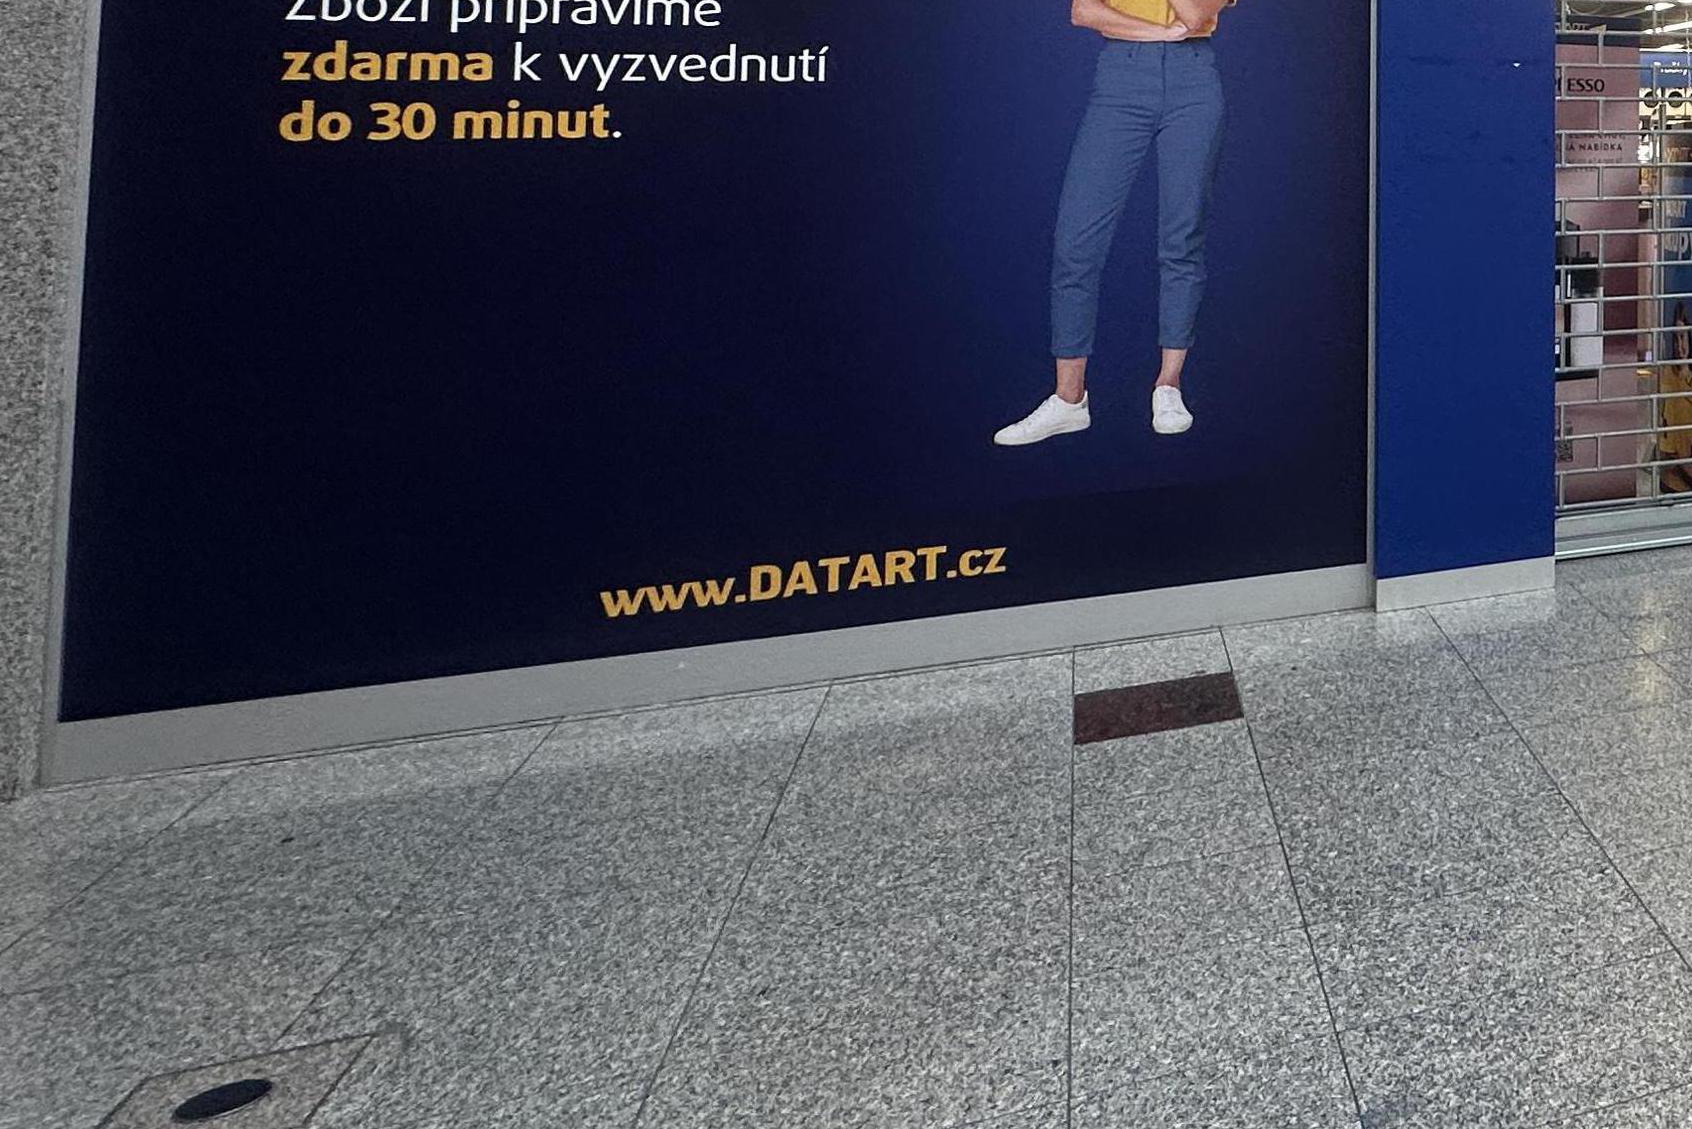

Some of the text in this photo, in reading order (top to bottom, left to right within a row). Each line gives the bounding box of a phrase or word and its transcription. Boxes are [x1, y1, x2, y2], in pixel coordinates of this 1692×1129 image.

[281, 39, 829, 92] zdarma k vyzvednutí
[279, 99, 622, 142] do 30 minut.
[600, 546, 1007, 617] www.DATART.cz
